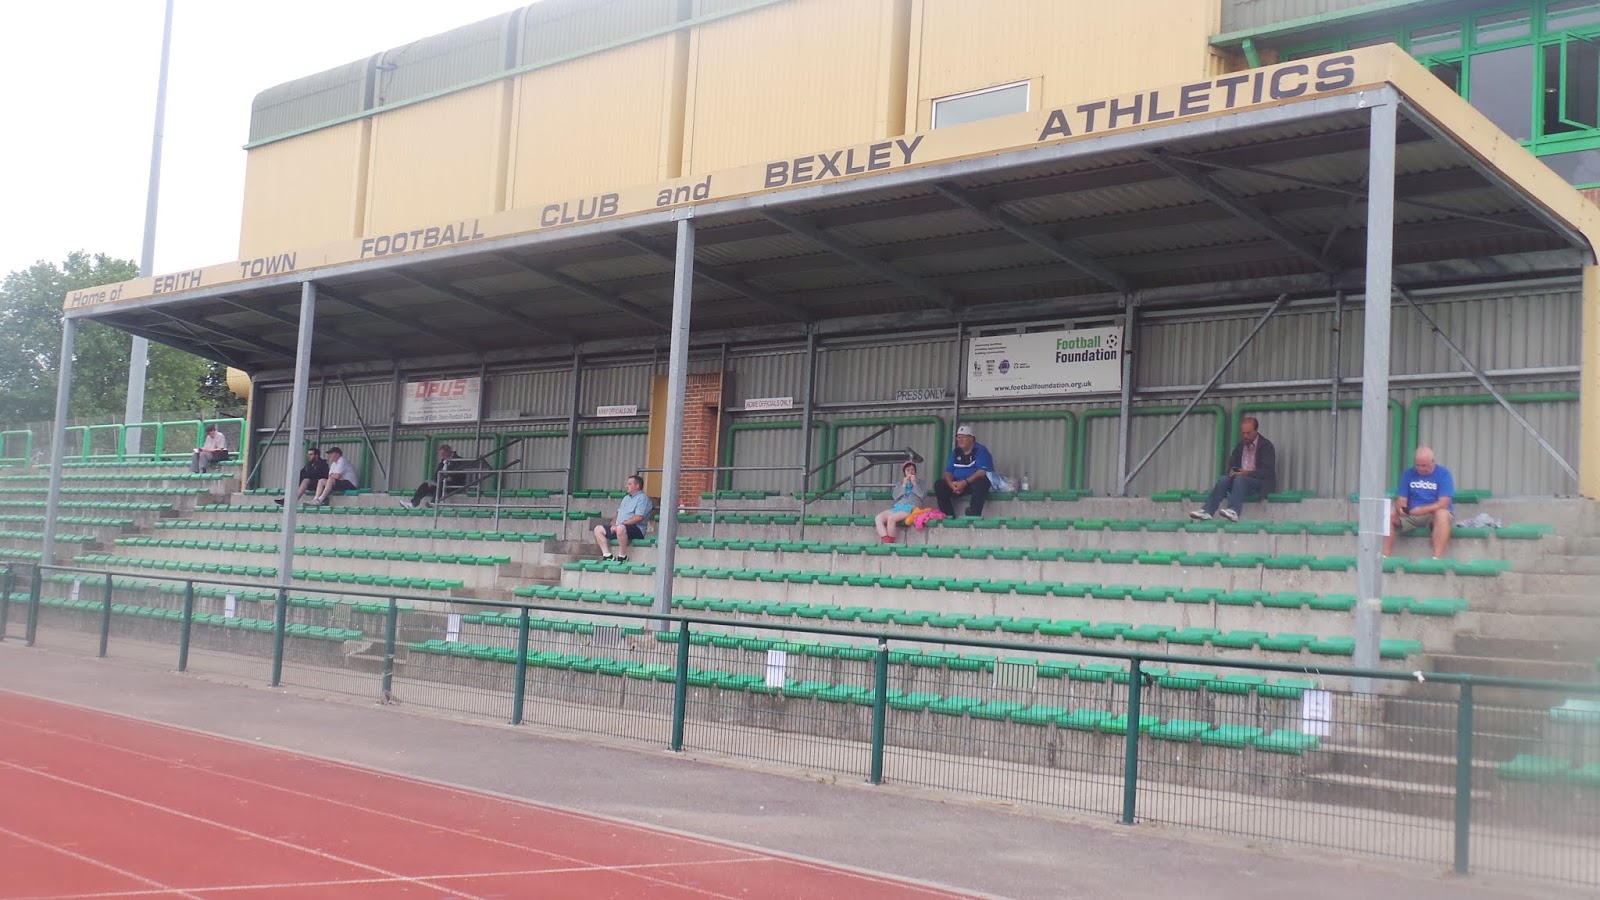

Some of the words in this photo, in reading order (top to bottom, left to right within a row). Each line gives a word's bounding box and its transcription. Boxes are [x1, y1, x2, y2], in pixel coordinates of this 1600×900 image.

[72, 287, 106, 308] Home
[109, 284, 123, 301] of
[153, 270, 202, 294] ERITH
[240, 251, 297, 279] TOWN
[360, 218, 485, 258] FOOTBALL
[541, 193, 620, 227] CLUB
[656, 175, 712, 206] and
[764, 135, 924, 188] BEXLEY
[1038, 55, 1355, 141] ATHLETICS
[1056, 336, 1100, 350] Football
[1056, 348, 1117, 363] Foundation
[995, 380, 1092, 392] www.footballfoundation.org.uk
[897, 390, 923, 400] PRESS
[924, 389, 945, 399] ONLY
[1410, 480, 1437, 490] adidas
